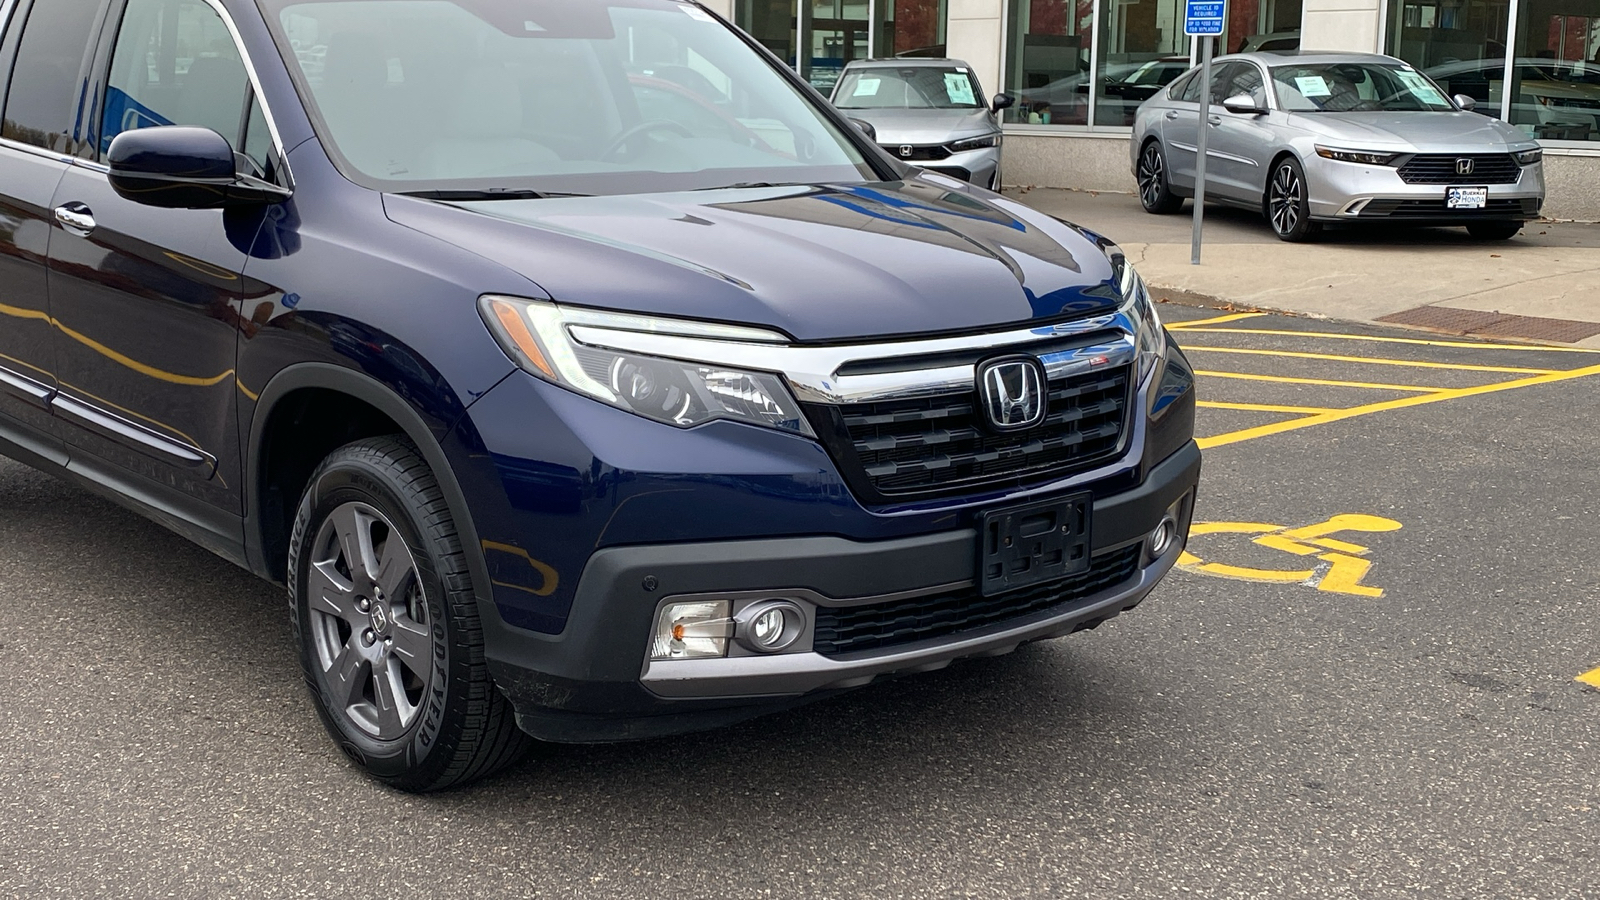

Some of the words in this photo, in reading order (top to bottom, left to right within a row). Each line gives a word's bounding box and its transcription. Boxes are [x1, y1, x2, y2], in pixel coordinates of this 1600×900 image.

[1462, 195, 1485, 203] HONDA
[286, 507, 306, 645] SSURANCE
[419, 581, 446, 748] GOODYEAR
